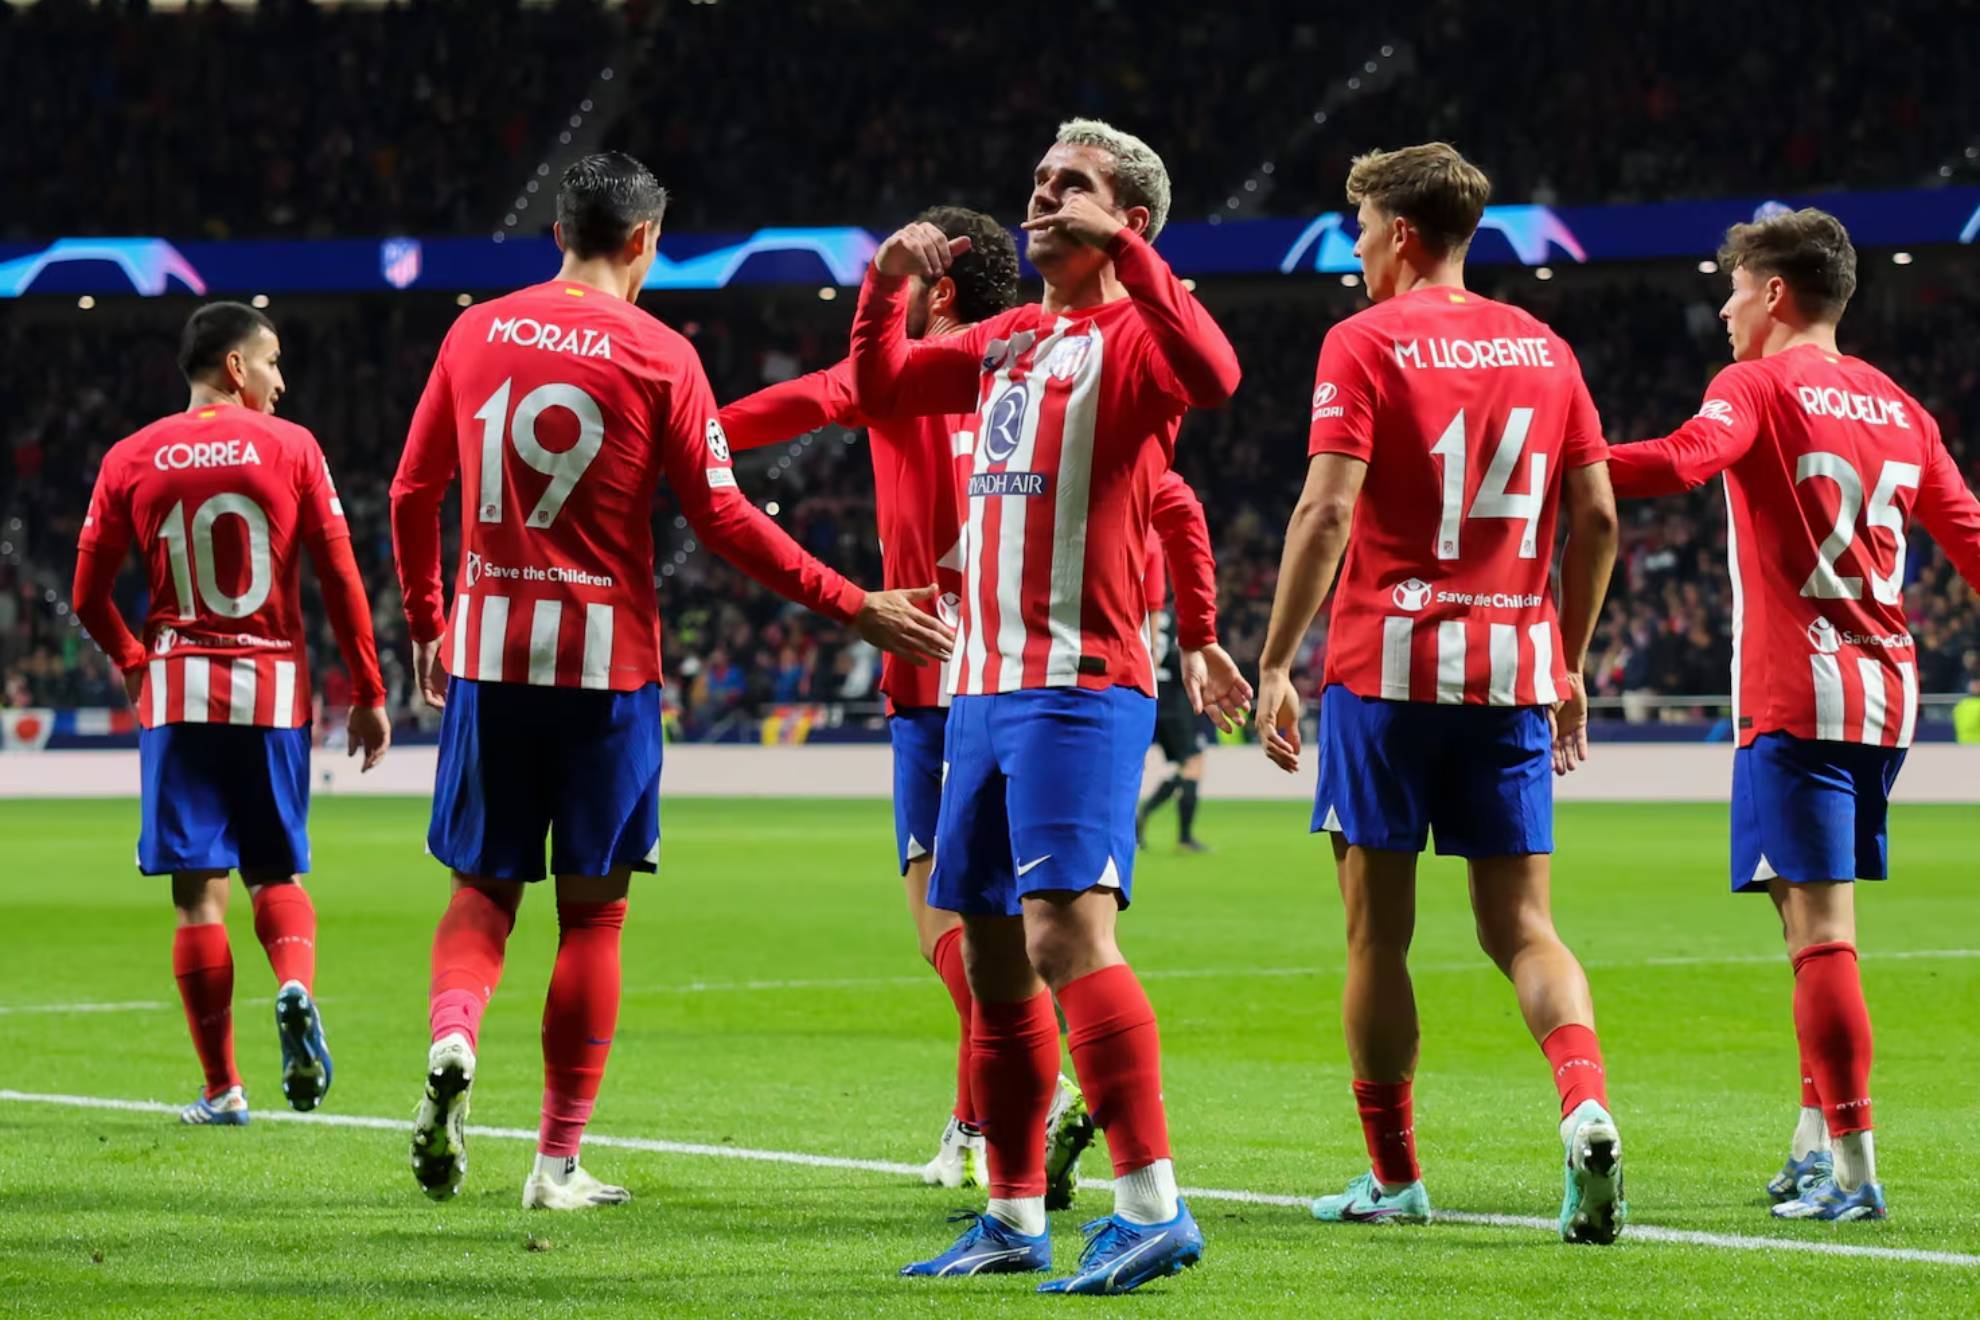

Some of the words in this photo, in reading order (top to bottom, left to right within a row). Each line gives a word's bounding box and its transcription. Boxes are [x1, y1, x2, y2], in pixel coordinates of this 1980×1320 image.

[487, 316, 612, 360] MORATA
[1394, 338, 1428, 369] M.
[1428, 337, 1554, 369] LLORENTE
[1798, 386, 1911, 429] RIQUELME
[154, 440, 261, 471] CORREA
[473, 375, 605, 529] 19
[1009, 474, 1042, 494] AIR
[1428, 407, 1548, 560] 14
[1796, 452, 1921, 606] 25
[157, 492, 273, 621] 10
[484, 561, 519, 579] Save
[522, 565, 546, 581] the
[547, 567, 613, 587] Children
[1842, 630, 1881, 646] Save
